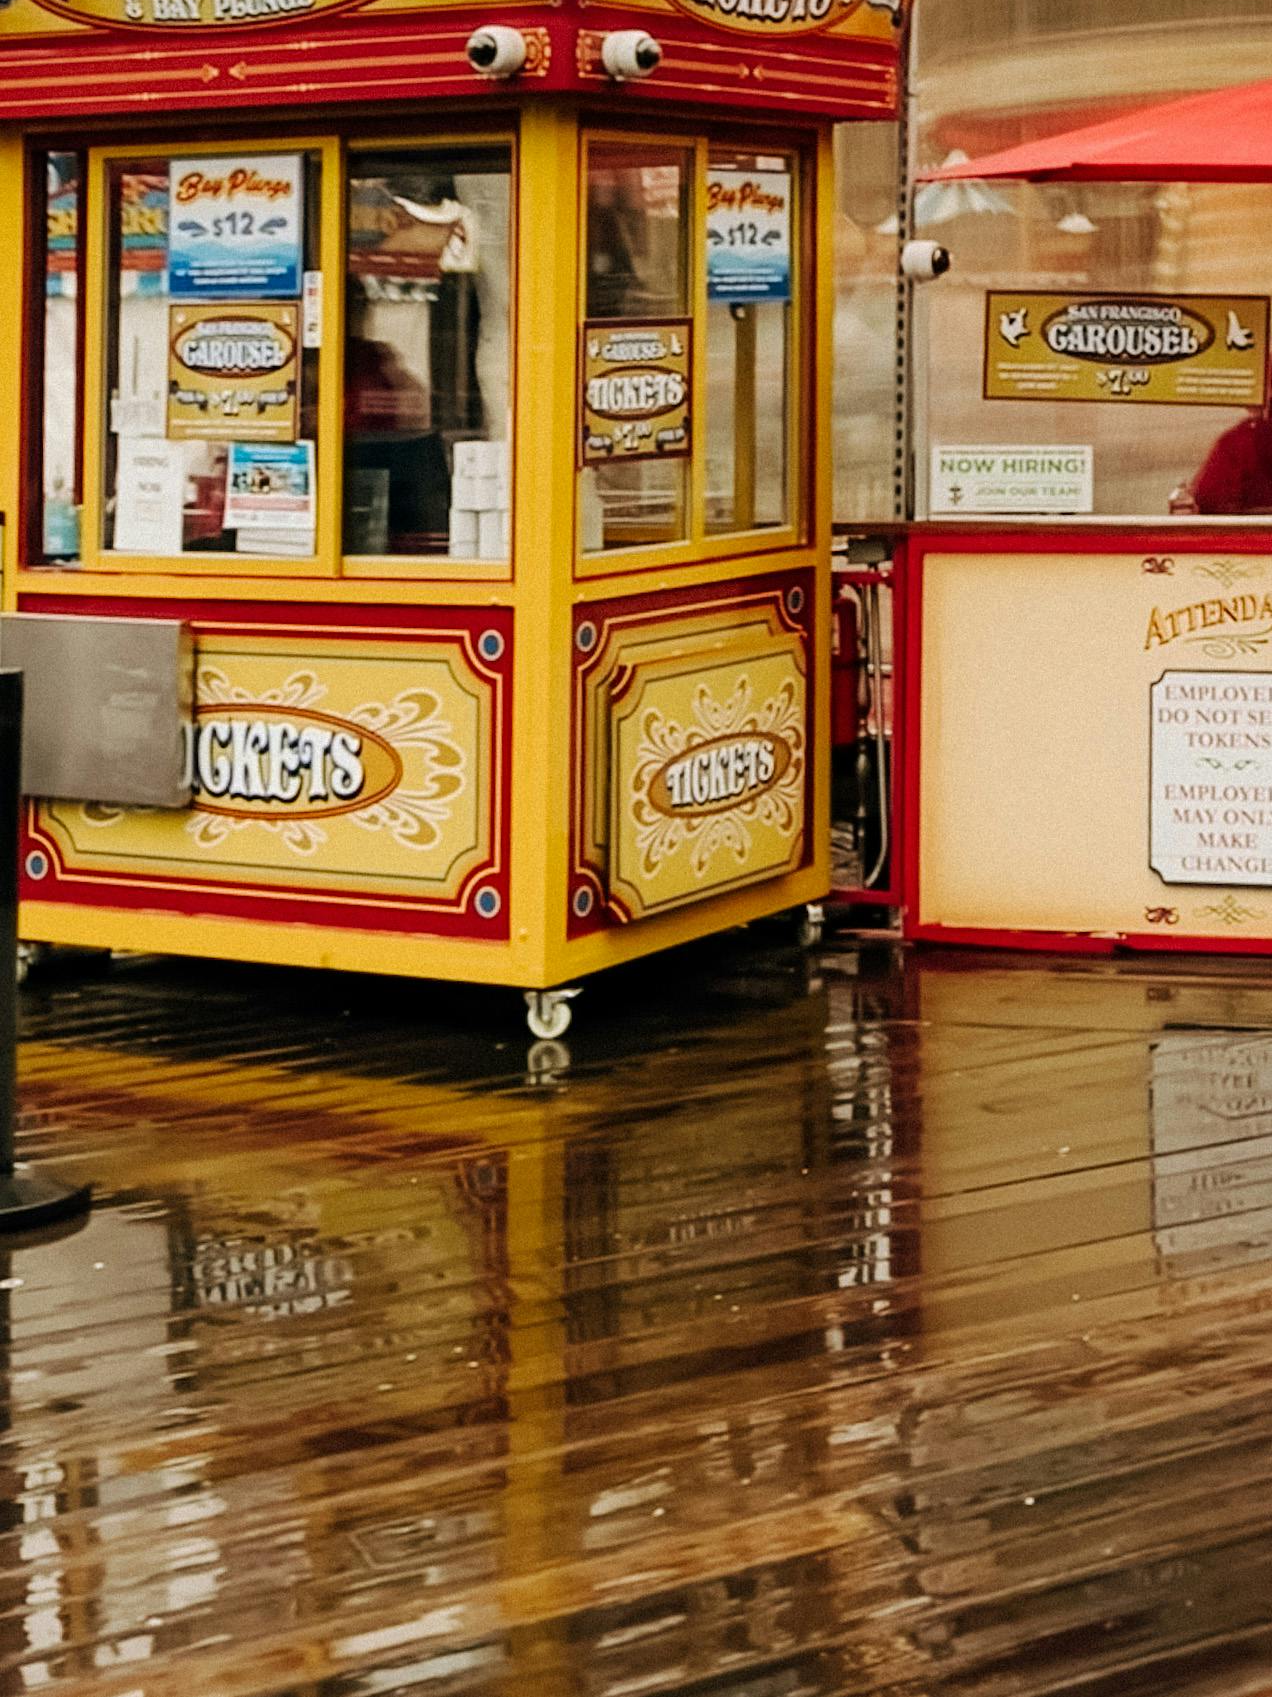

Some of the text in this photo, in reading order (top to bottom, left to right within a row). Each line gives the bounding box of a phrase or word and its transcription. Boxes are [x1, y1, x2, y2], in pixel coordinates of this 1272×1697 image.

[176, 167, 292, 205] Bay Plunge
[212, 210, 255, 238] $12
[727, 221, 758, 246] $12
[1067, 304, 1182, 323] SAN FRANCISCO
[1047, 323, 1200, 356] CAROUSEL
[182, 340, 286, 368] CAROUSEL
[586, 373, 685, 411] TICKETS
[940, 458, 1086, 475] NOW HIRING!
[976, 486, 1006, 497] JOIN
[1009, 486, 1038, 497] OUR
[1158, 707, 1190, 725] DO
[1194, 707, 1242, 726] NOT
[1186, 730, 1272, 750] TOKENS
[665, 739, 777, 807] TICKETS
[1171, 807, 1217, 825] MAY
[1196, 831, 1259, 851] MAKE
